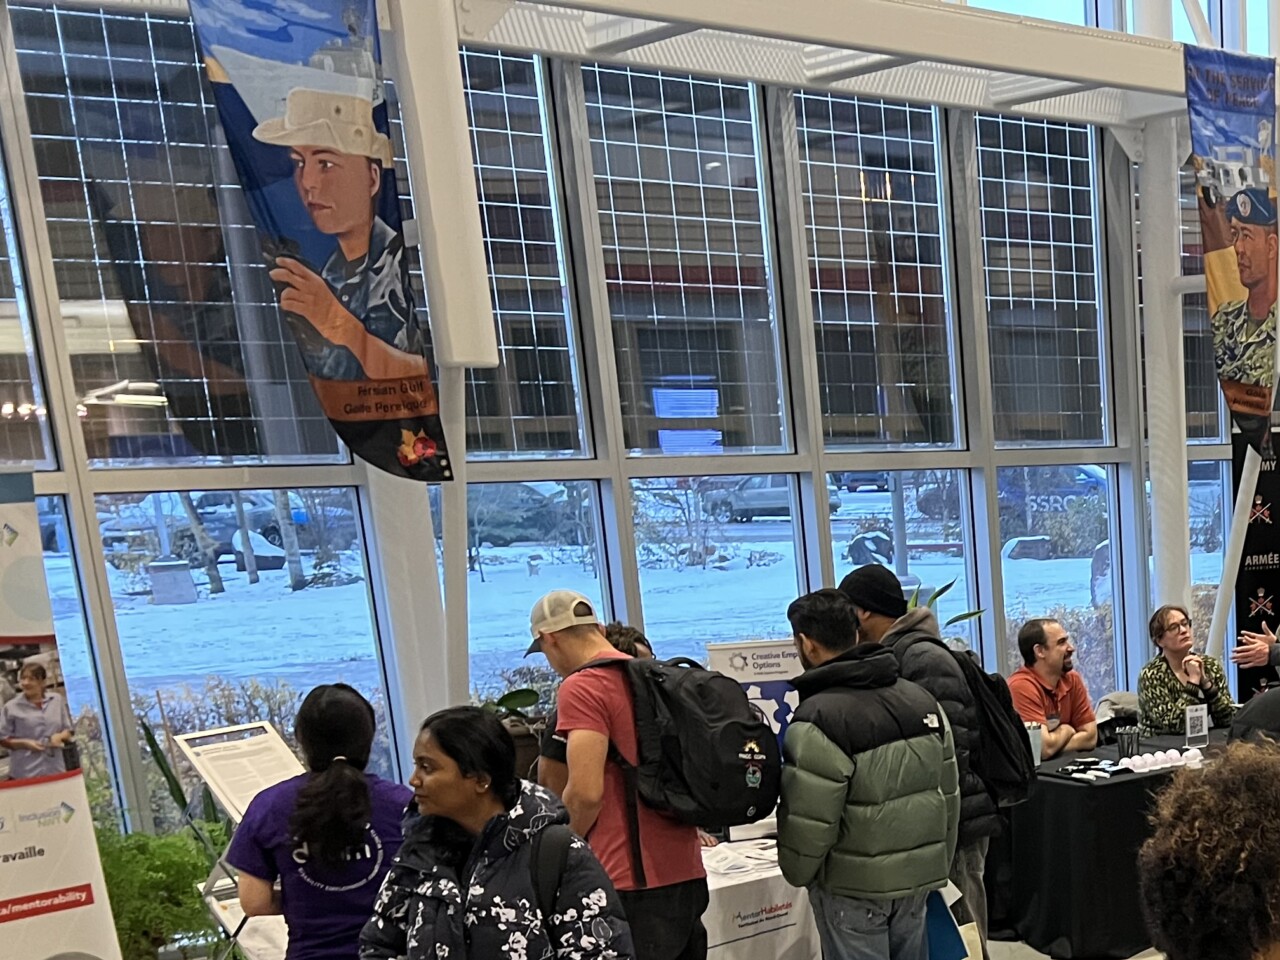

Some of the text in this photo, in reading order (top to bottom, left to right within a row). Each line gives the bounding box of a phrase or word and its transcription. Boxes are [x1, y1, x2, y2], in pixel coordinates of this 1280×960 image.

[1245, 552, 1279, 566] ARMÉE
[751, 652, 781, 660] Creative
[752, 661, 781, 670] Options
